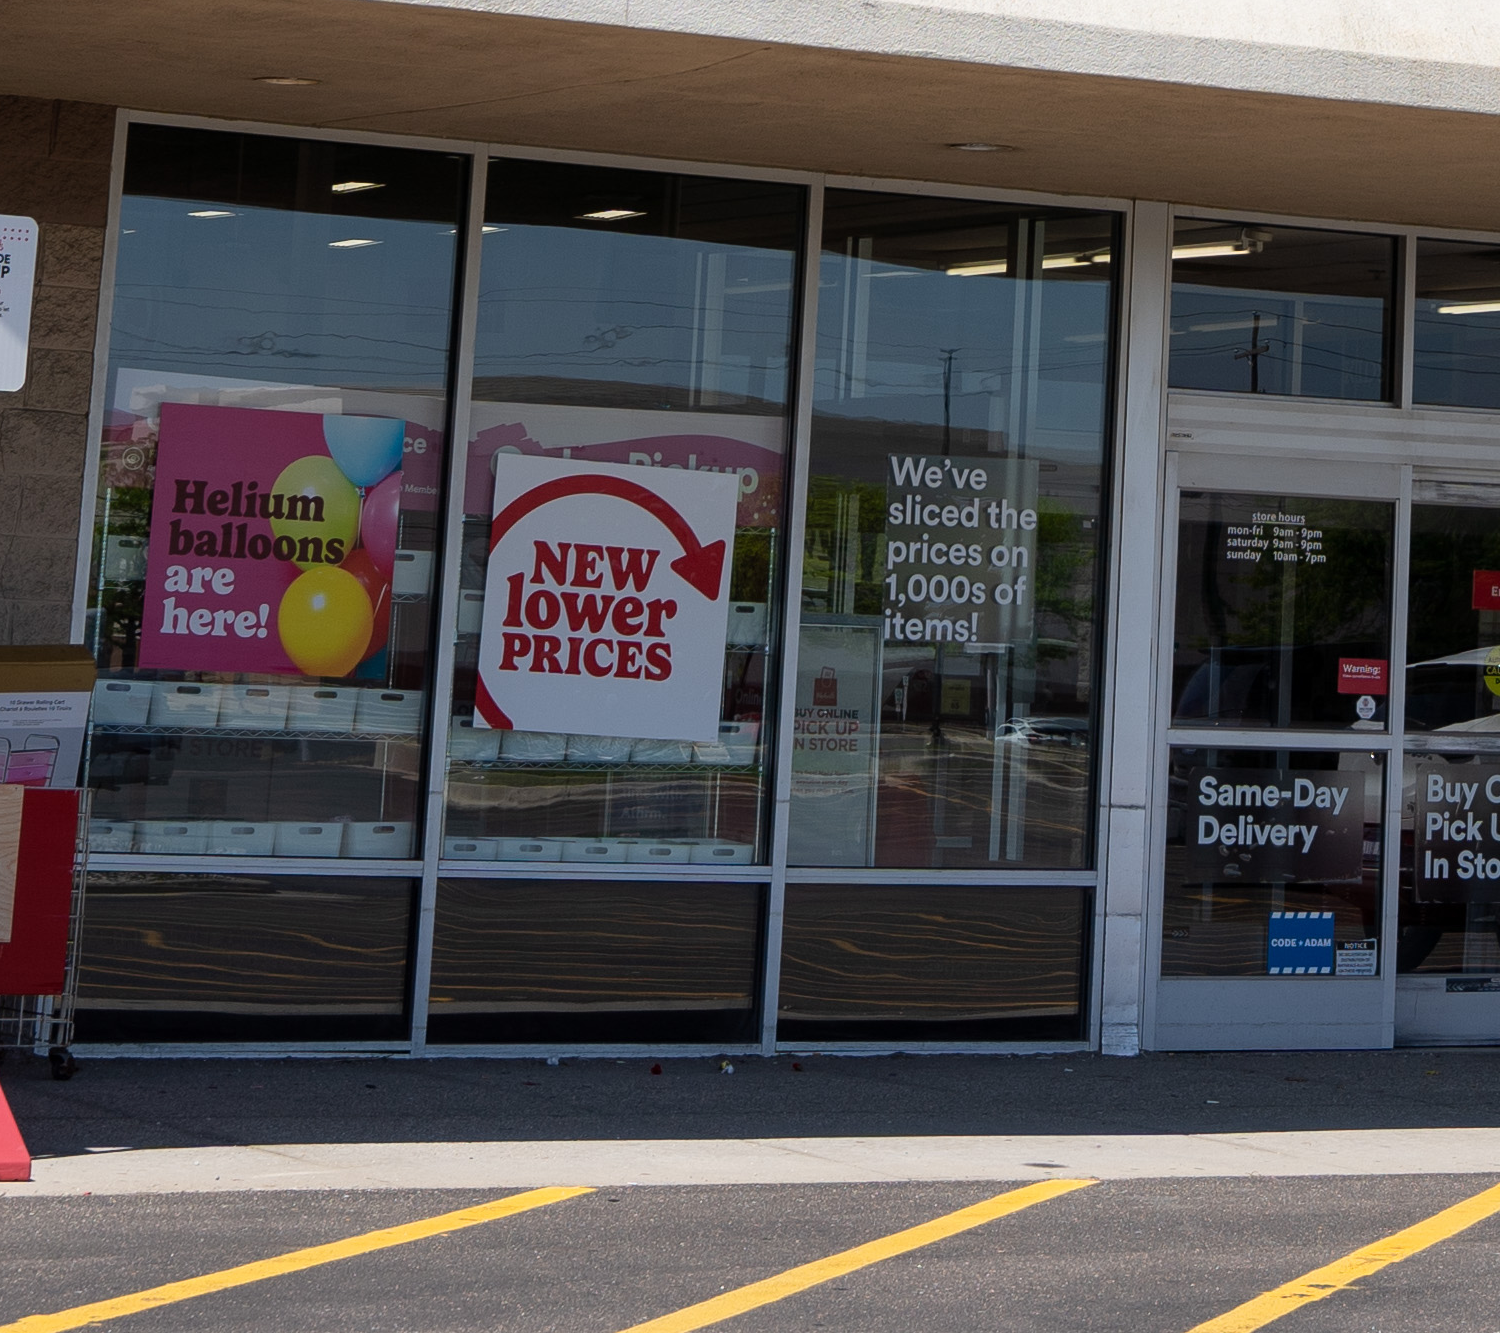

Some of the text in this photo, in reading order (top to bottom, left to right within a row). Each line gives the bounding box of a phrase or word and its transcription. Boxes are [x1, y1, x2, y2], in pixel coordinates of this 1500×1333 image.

[171, 479, 325, 522] Helium
[888, 494, 1037, 530] sliced the
[1227, 524, 1263, 536] mon-fri
[1273, 526, 1294, 537] 9am
[1301, 527, 1323, 539] 9pm
[1252, 512, 1305, 524] store hours
[168, 519, 345, 564] balloons
[887, 533, 1029, 570] prices on
[1226, 536, 1269, 551] saturday
[1272, 538, 1293, 549] 9am
[1300, 539, 1322, 551] 9pm
[1226, 549, 1262, 563] sunday
[1273, 551, 1298, 562] 10am
[1305, 552, 1327, 565] 7pm
[163, 564, 235, 595] are
[530, 540, 660, 593] NEW
[502, 572, 678, 638] lower
[885, 573, 1028, 607] 1,000s of
[159, 596, 270, 639] here!
[883, 608, 979, 642] items!
[498, 632, 672, 682] PRICES
[1342, 663, 1381, 675] Warning:
[817, 709, 859, 719] ONLINE
[836, 720, 860, 736] UP
[809, 737, 858, 752] STORE
[1198, 775, 1350, 815] Same-Day
[1426, 774, 1479, 810] Buy
[1197, 814, 1318, 854] Delivery
[1425, 811, 1484, 841] Pick
[1424, 850, 1450, 879] In
[1271, 937, 1332, 948] CODE ADAM
[1344, 941, 1368, 950] NOTICE
